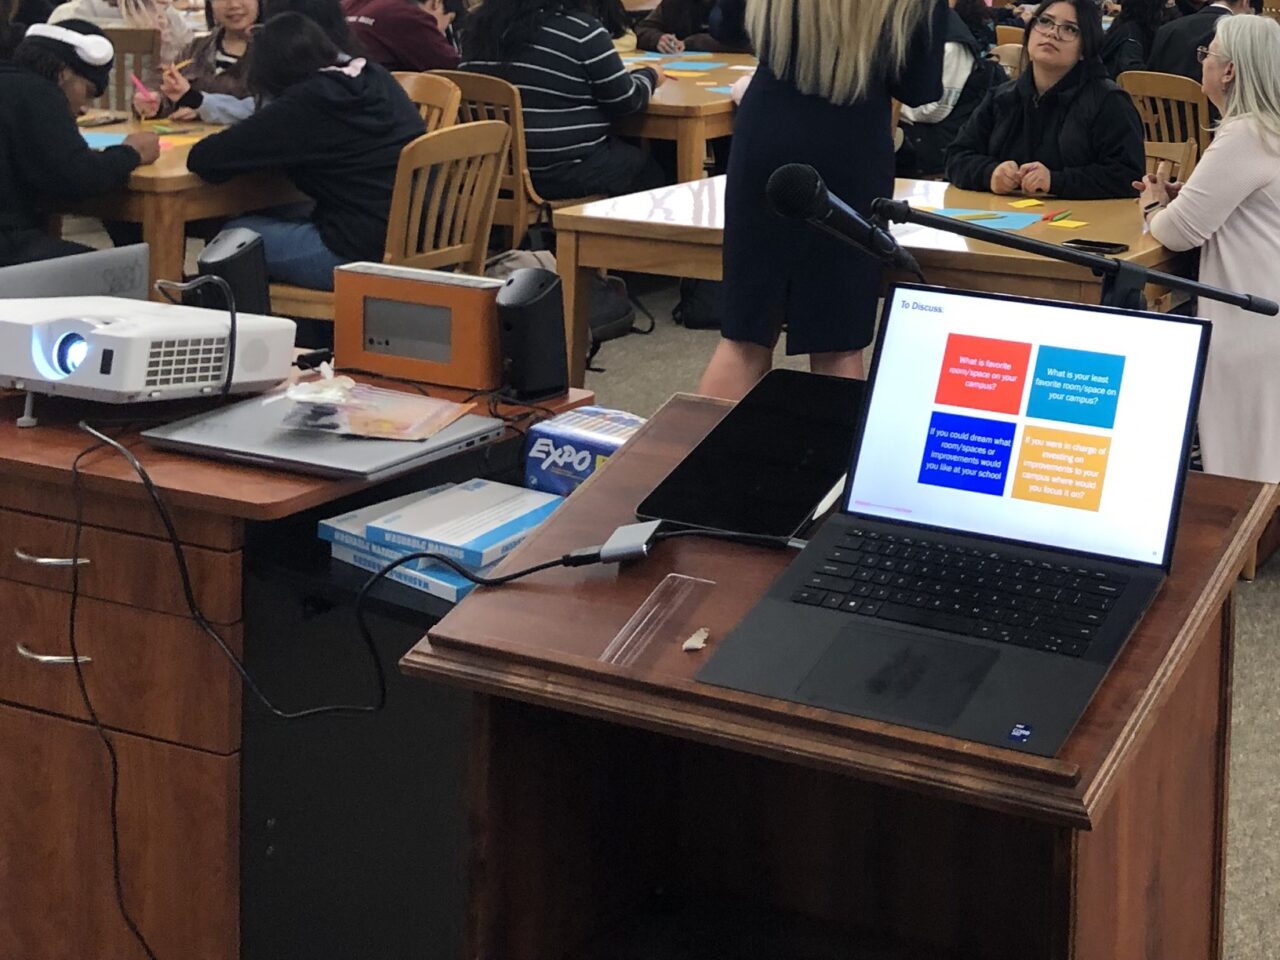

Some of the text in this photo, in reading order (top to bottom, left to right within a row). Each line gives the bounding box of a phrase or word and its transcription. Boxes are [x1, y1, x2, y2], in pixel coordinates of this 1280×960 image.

[901, 300, 910, 310] To
[960, 356, 978, 366] What
[985, 358, 1012, 371] favorite
[949, 367, 1018, 382] room/space on your
[1047, 368, 1109, 384] What is your least
[964, 380, 998, 391] campus?
[1035, 377, 1117, 396] favorite room/space on
[1048, 392, 1099, 405] your campus?
[929, 427, 1012, 447] If you could dream what
[528, 438, 592, 471] EXPO
[941, 441, 996, 456] room/spaces or
[925, 462, 1002, 480] you like at your school
[980, 459, 1002, 468] would
